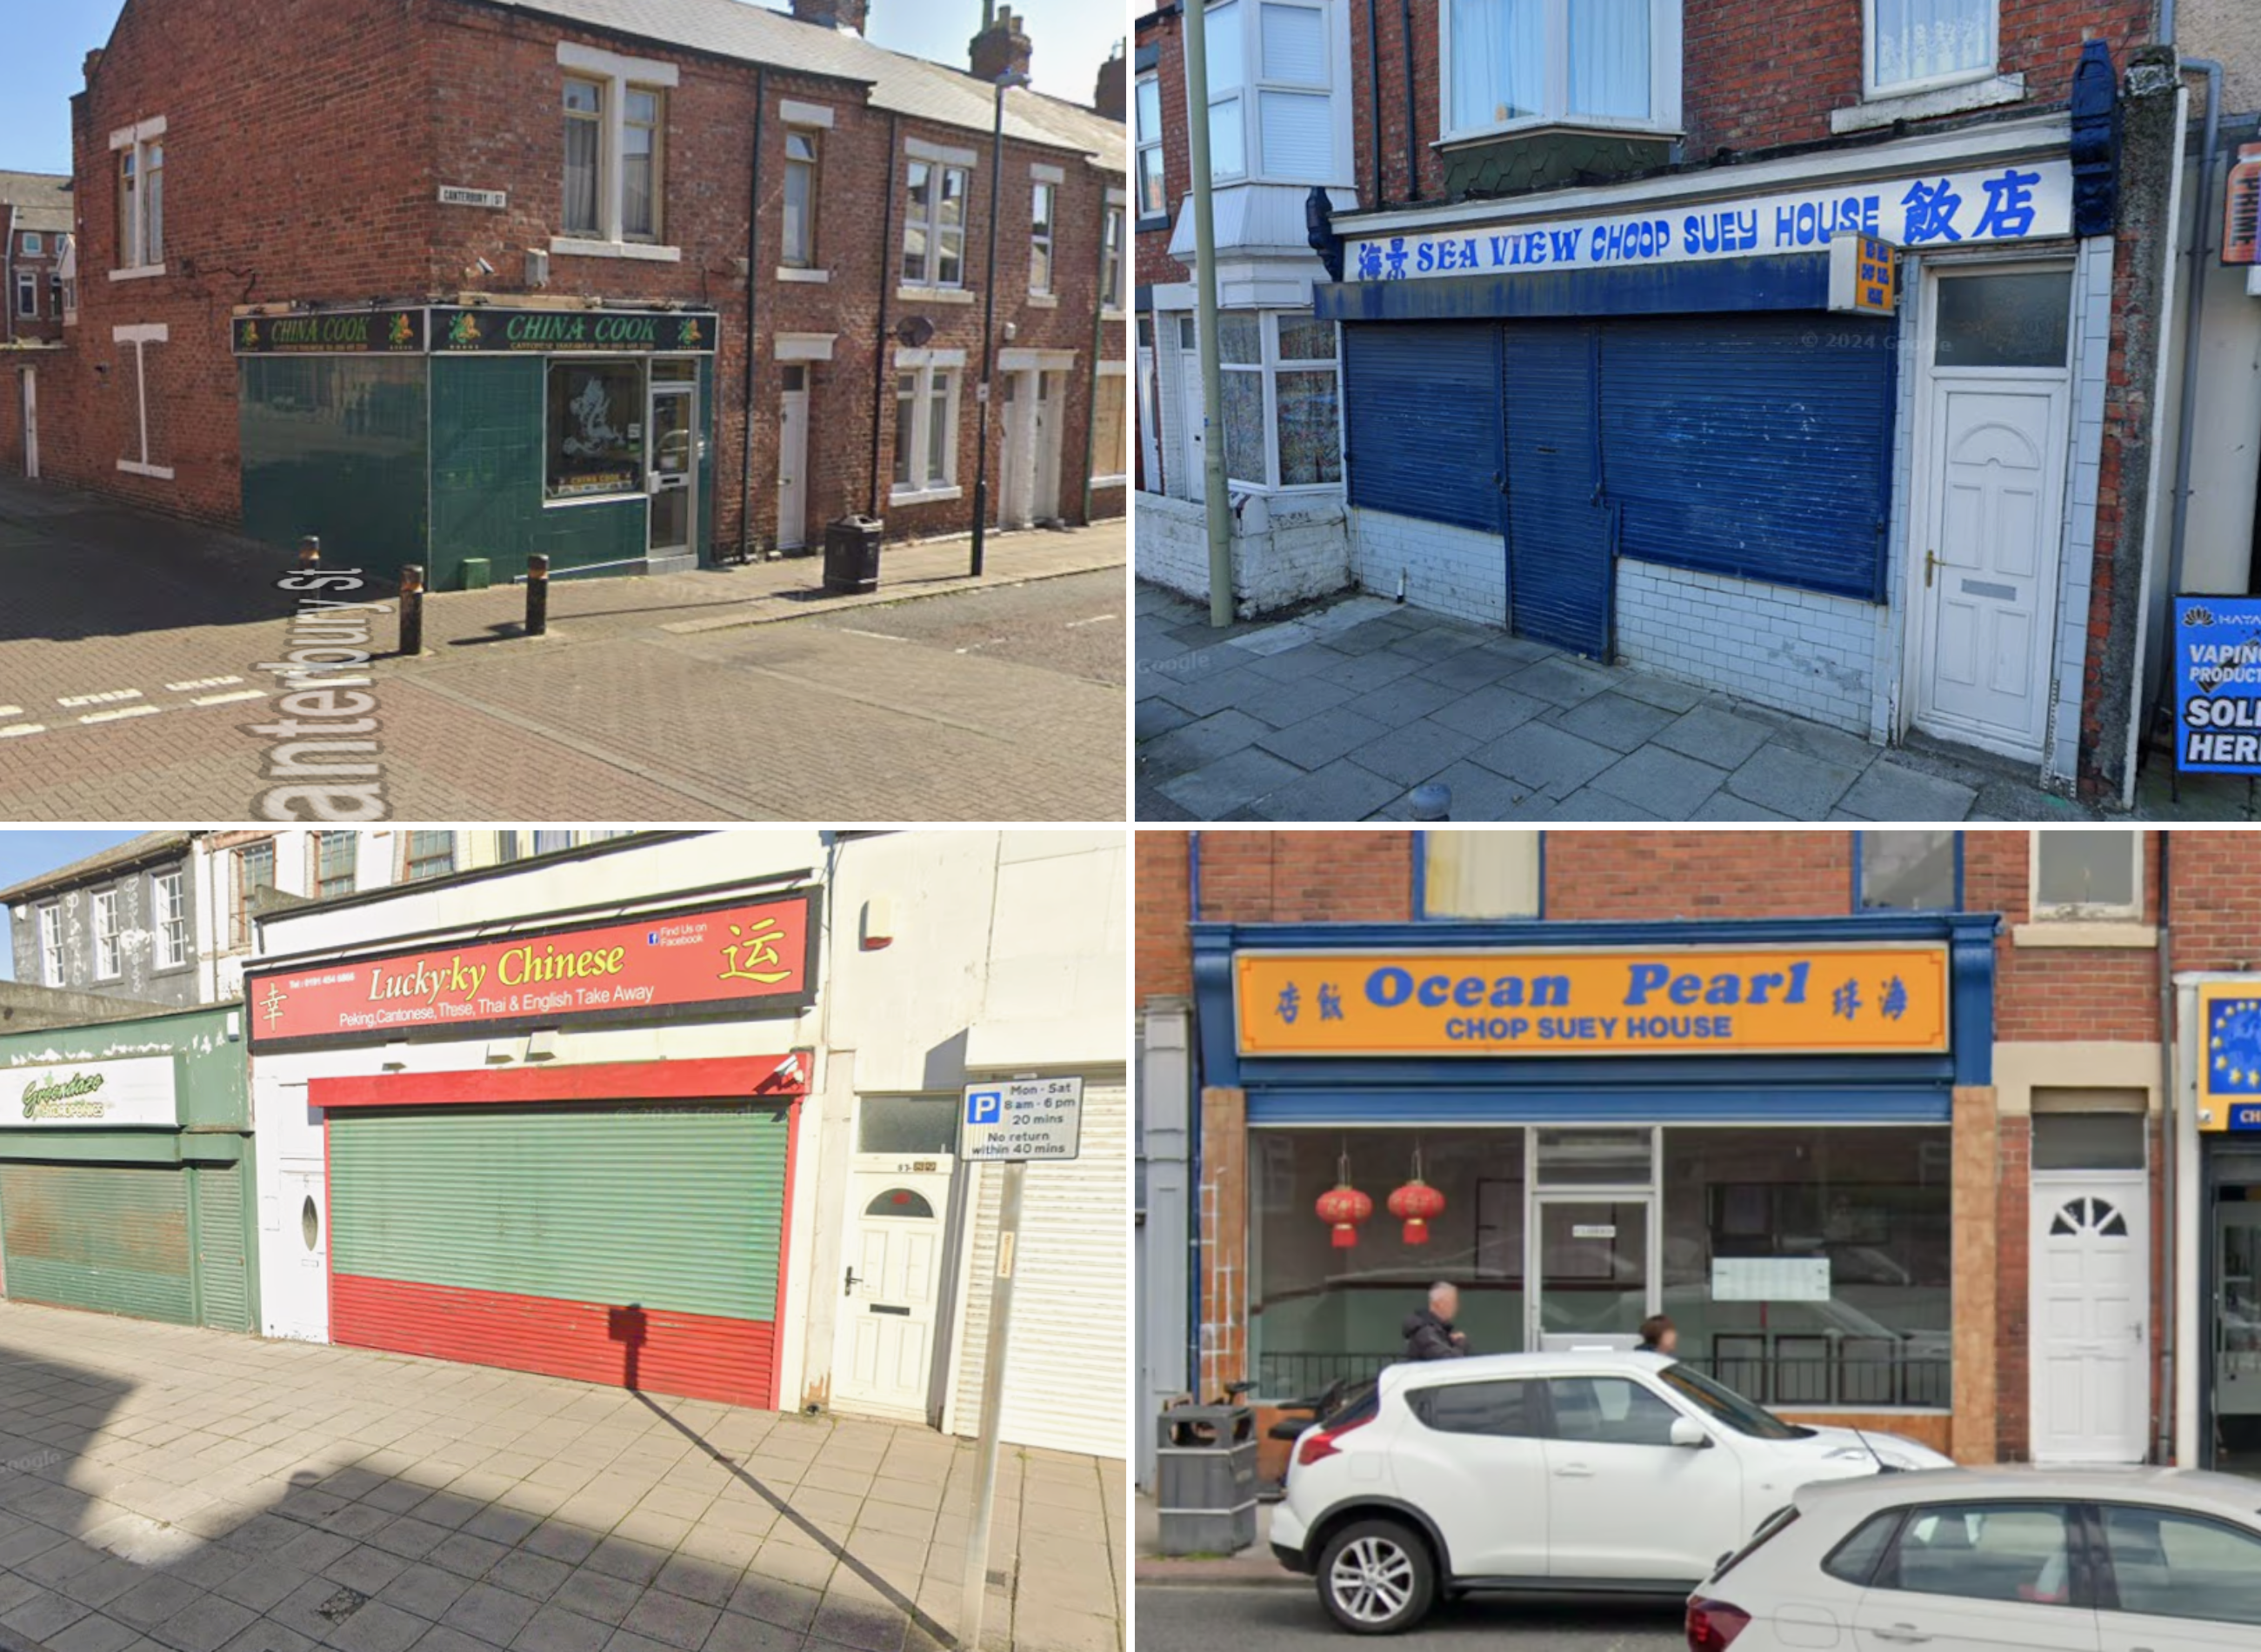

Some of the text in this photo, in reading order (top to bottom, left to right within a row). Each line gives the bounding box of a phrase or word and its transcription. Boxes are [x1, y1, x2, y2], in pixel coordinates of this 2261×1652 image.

[1417, 238, 1480, 272] SEA
[1490, 228, 1583, 266] VIEW
[1590, 219, 1670, 261] CHOOP
[1684, 209, 1757, 256] SUEY
[1775, 196, 1880, 247] HOUSE
[1900, 170, 2042, 244] 飯店
[271, 316, 370, 342] CHINA COOK
[506, 315, 657, 341] CHINA COOK
[2190, 644, 2261, 663] VAPIN
[2188, 735, 2261, 762] HER
[660, 923, 707, 937] Find Us on
[660, 934, 704, 947] Facebook
[717, 917, 793, 984] 运
[497, 945, 625, 986] Chinese
[1364, 961, 1811, 1008] Ocean Pearl
[259, 982, 288, 1032] 幸
[478, 997, 506, 1013] Thai
[509, 996, 519, 1011] &
[523, 991, 572, 1013] English
[576, 988, 609, 1005] Take
[613, 985, 654, 1003] Away
[1446, 1016, 1732, 1040] CHOP SUEY HOUSE
[1010, 1085, 1037, 1095] Mon
[1048, 1083, 1070, 1093] Sat
[975, 1096, 996, 1122] P
[1004, 1100, 1012, 1109] 8
[1044, 1097, 1052, 1108] 6
[1055, 1098, 1076, 1109] pm
[1012, 1115, 1064, 1125] 20 mins
[971, 1143, 1065, 1155] within 40 mins
[988, 1132, 1050, 1142] No return
